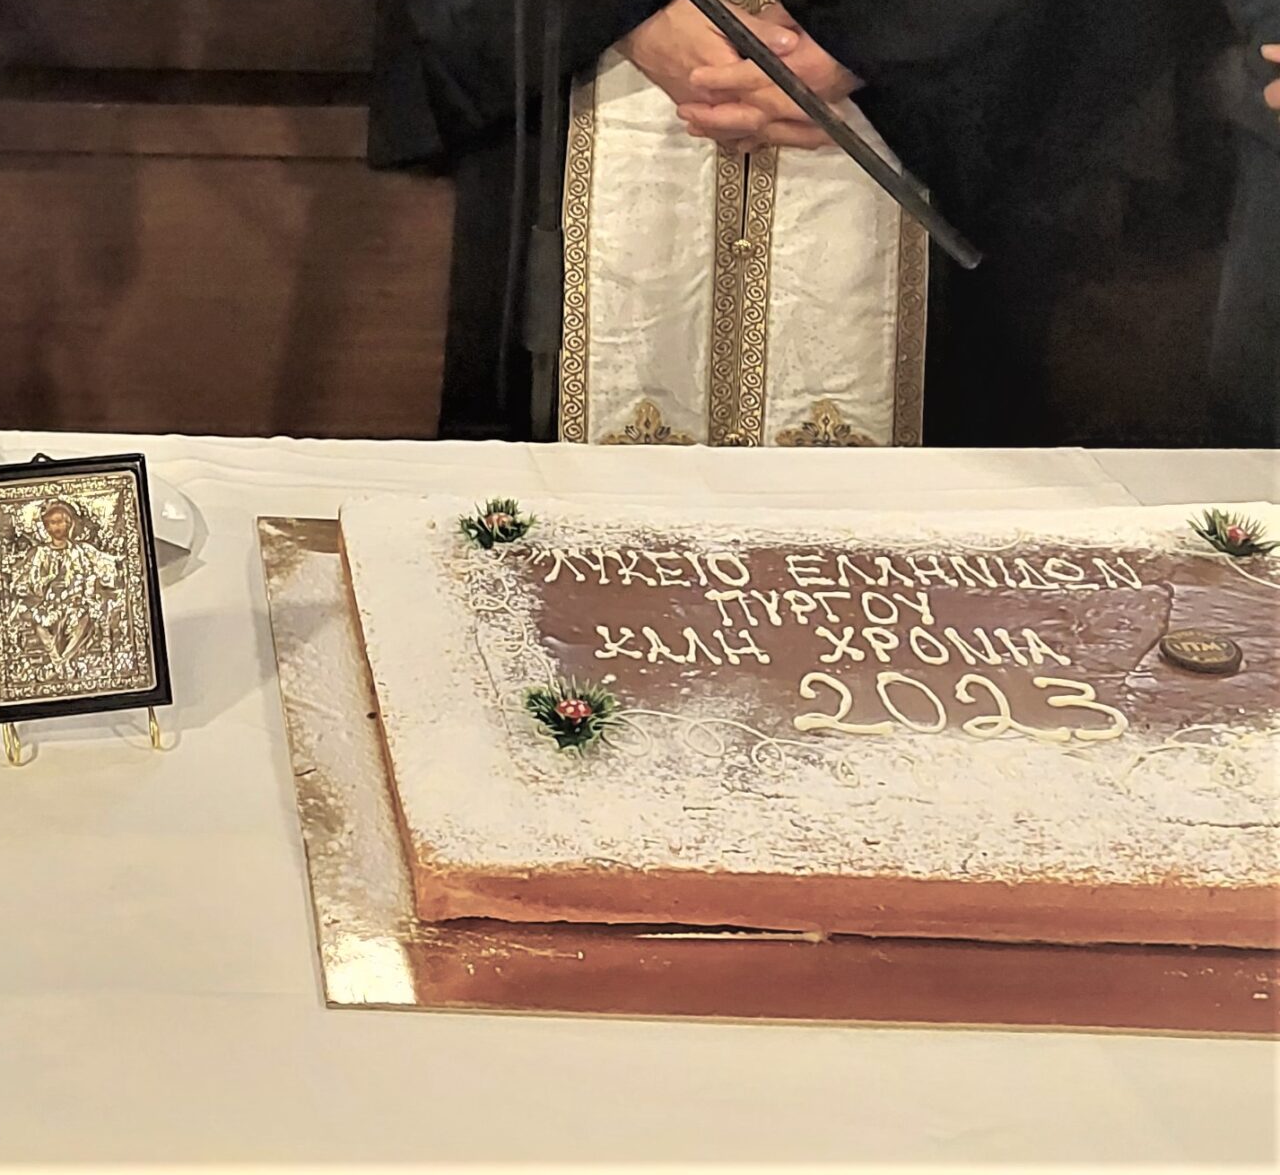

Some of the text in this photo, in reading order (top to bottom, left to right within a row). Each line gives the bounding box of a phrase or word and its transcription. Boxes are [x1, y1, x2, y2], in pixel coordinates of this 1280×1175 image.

[704, 589, 935, 627] ΠΥΡΓΟΥ
[593, 625, 1072, 666] ΚΑΛΗ ΧΡΟΝΙΑ
[793, 670, 1130, 744] 2023
